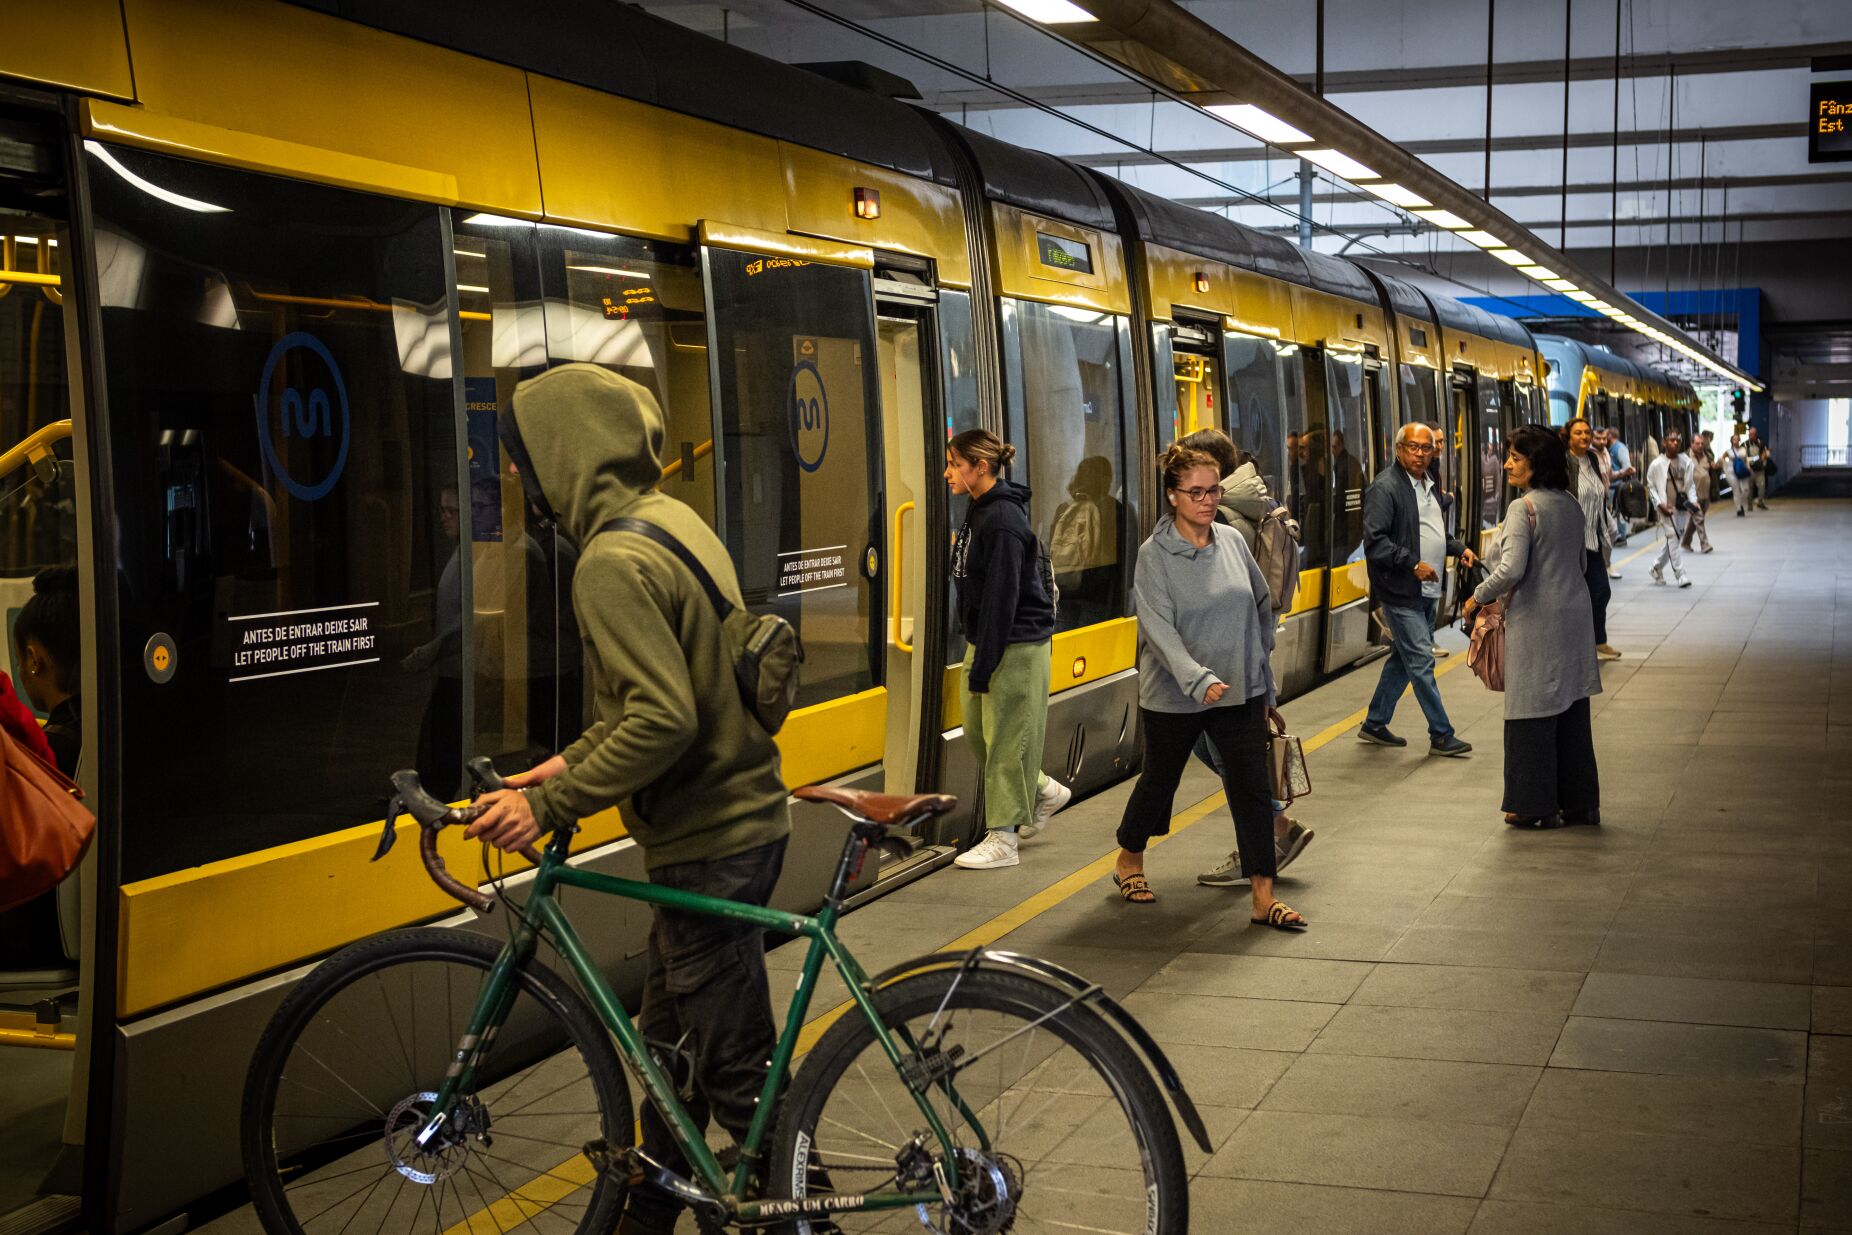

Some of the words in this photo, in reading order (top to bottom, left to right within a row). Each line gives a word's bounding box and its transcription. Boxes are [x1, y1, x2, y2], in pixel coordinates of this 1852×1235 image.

[1818, 118, 1844, 133] Est
[784, 561, 798, 573] ANTES
[798, 560, 804, 570] DE
[804, 558, 820, 570] ENTRAR
[780, 575, 788, 587] LET
[788, 573, 805, 585] PEOPLE
[805, 572, 813, 582] OFF
[813, 570, 821, 581] THE
[821, 569, 834, 580] TRAIN
[833, 567, 845, 578] FIRST
[243, 628, 273, 645] ANTES
[275, 626, 287, 641] DE
[289, 622, 324, 639] ENTRAR
[324, 619, 349, 635] DEIXE
[349, 617, 368, 632] SAIR
[234, 650, 253, 666] LET
[254, 646, 289, 664] PEOPLE
[290, 644, 307, 658] OFF
[308, 641, 326, 656] THE
[326, 638, 352, 654] TRAIN
[352, 635, 375, 650] FIRST
[794, 1135, 809, 1200] ALEXRIMS
[760, 1201, 800, 1217] MENOS
[803, 1199, 821, 1212] UM
[824, 1195, 864, 1210] CARRO
